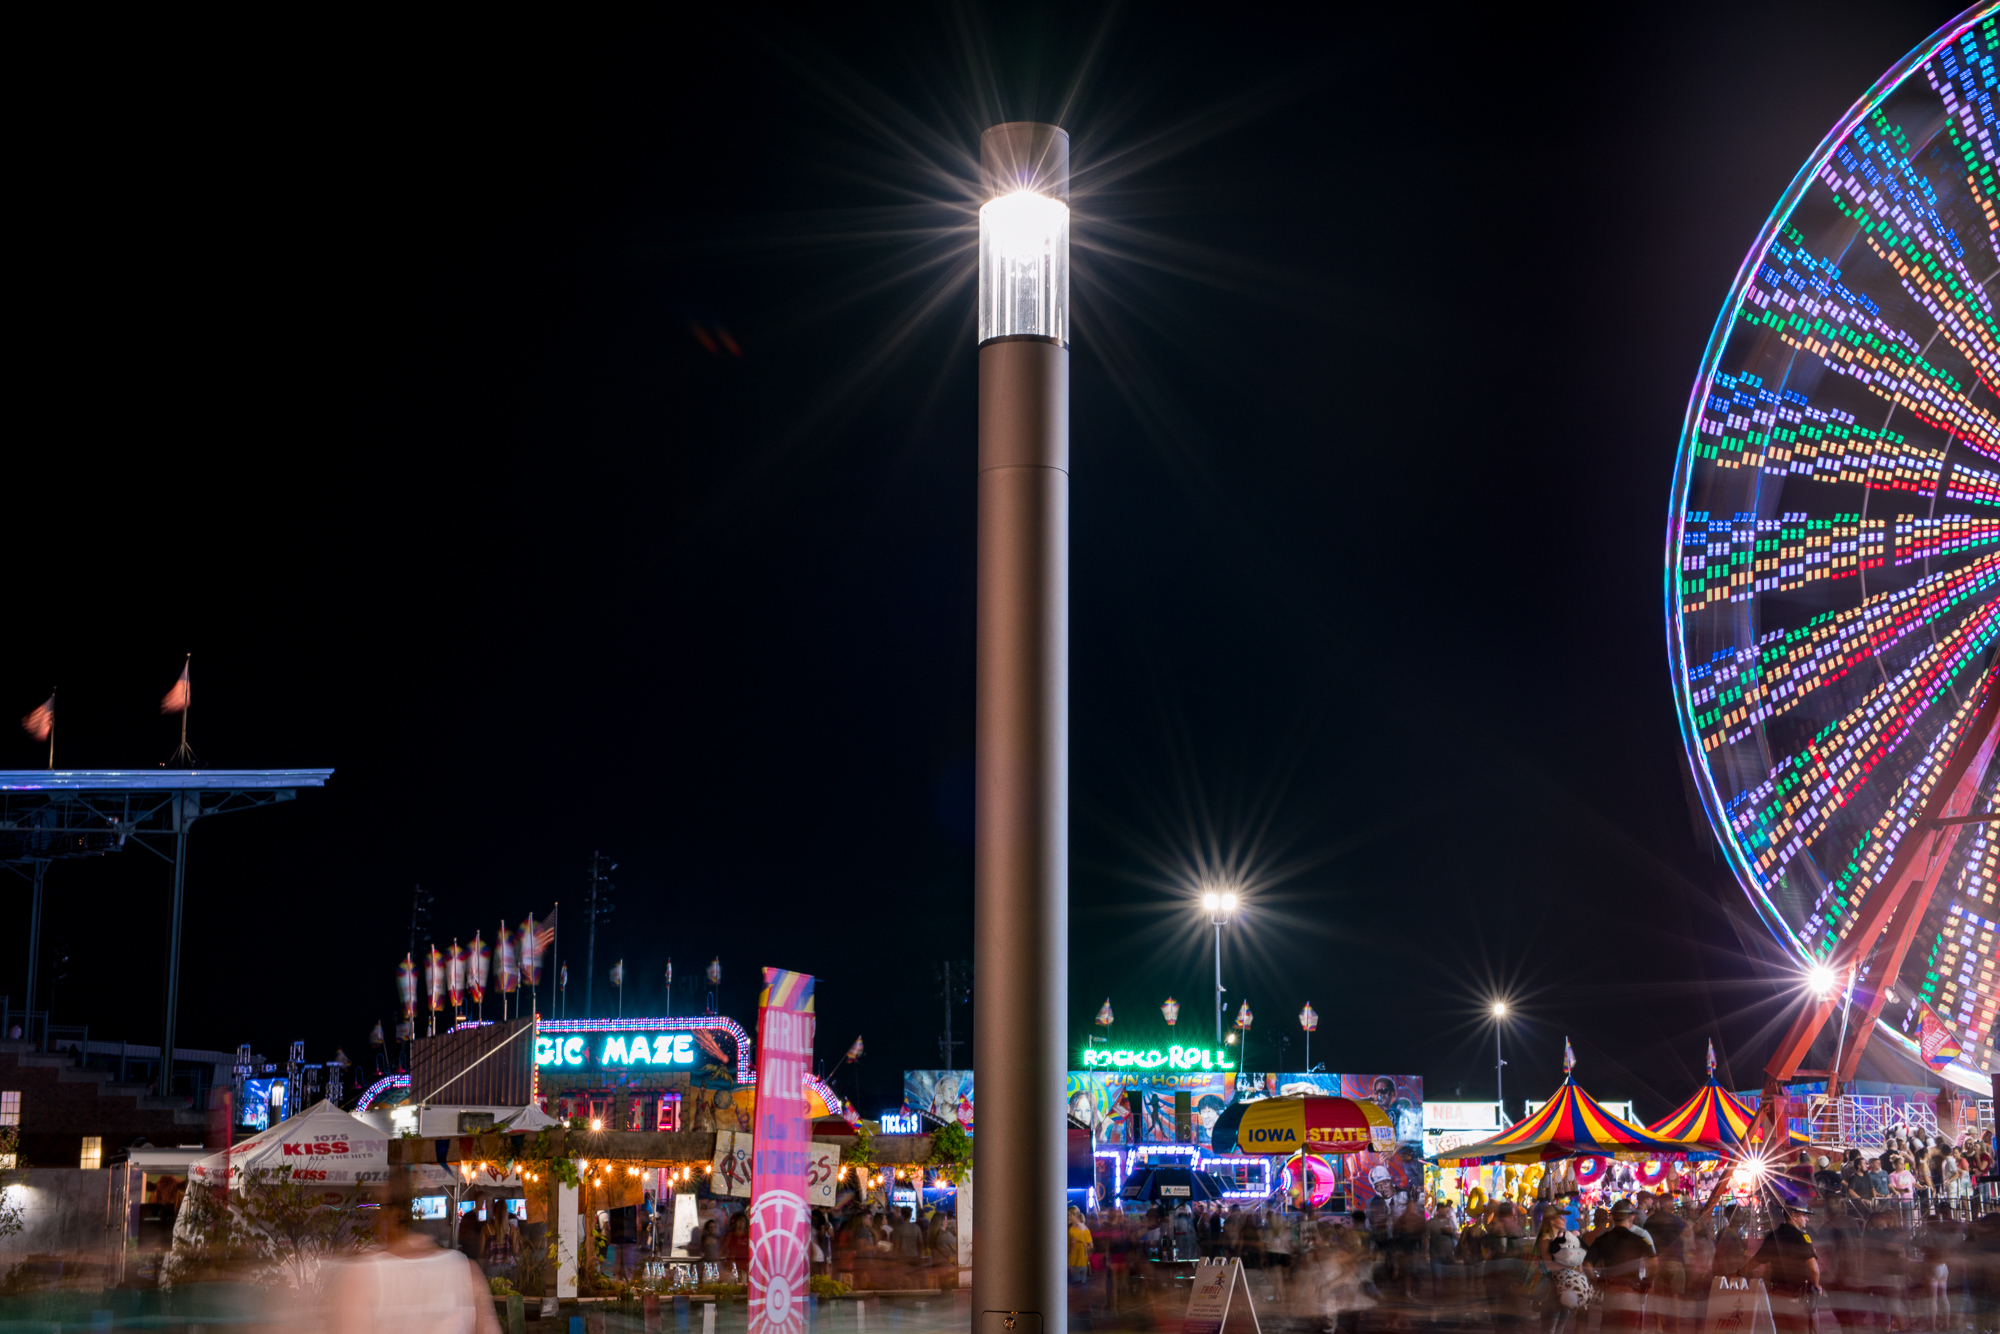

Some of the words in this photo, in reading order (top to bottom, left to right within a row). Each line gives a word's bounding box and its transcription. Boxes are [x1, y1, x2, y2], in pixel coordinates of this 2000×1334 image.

[602, 1034, 693, 1064] MAZE
[1168, 1045, 1234, 1069] ROLL
[1104, 1074, 1140, 1087] FUN
[1151, 1074, 1213, 1088] HOUSE
[1433, 1105, 1465, 1120] NBA
[313, 1134, 349, 1142] 107.5
[1249, 1129, 1296, 1142] IOWA
[1310, 1128, 1367, 1142] STATE
